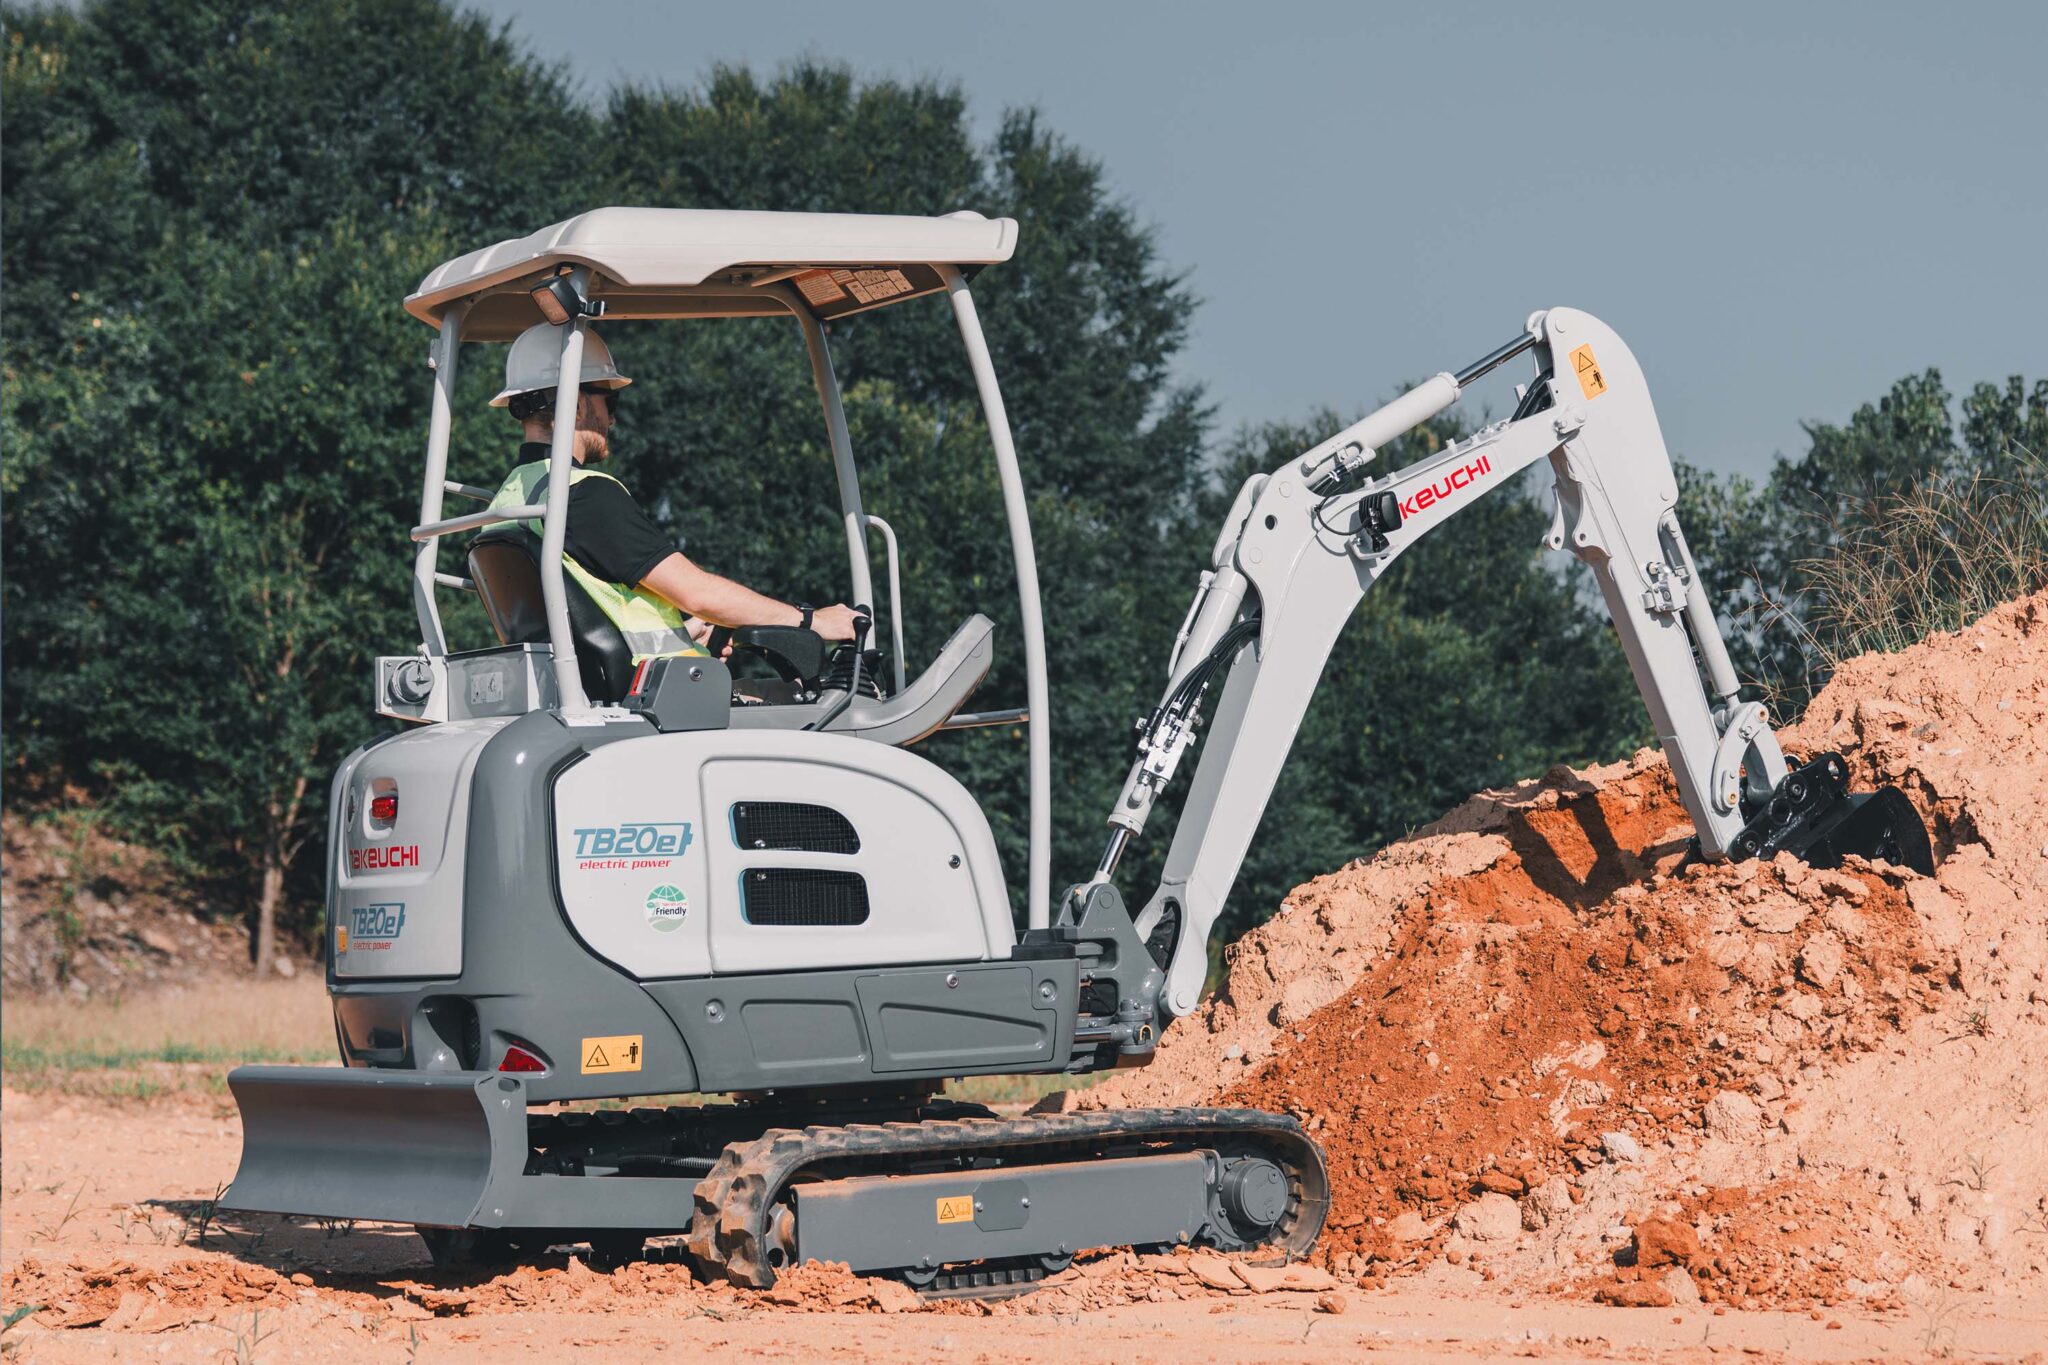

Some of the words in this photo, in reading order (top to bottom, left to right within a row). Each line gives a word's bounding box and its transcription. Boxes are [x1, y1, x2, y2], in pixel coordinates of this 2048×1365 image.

[1398, 455, 1491, 520] KEUCHI
[574, 826, 677, 856] TB20e
[579, 859, 629, 870] electric
[631, 859, 672, 871] power
[352, 907, 396, 935] TB20e
[655, 906, 687, 917] Friendly
